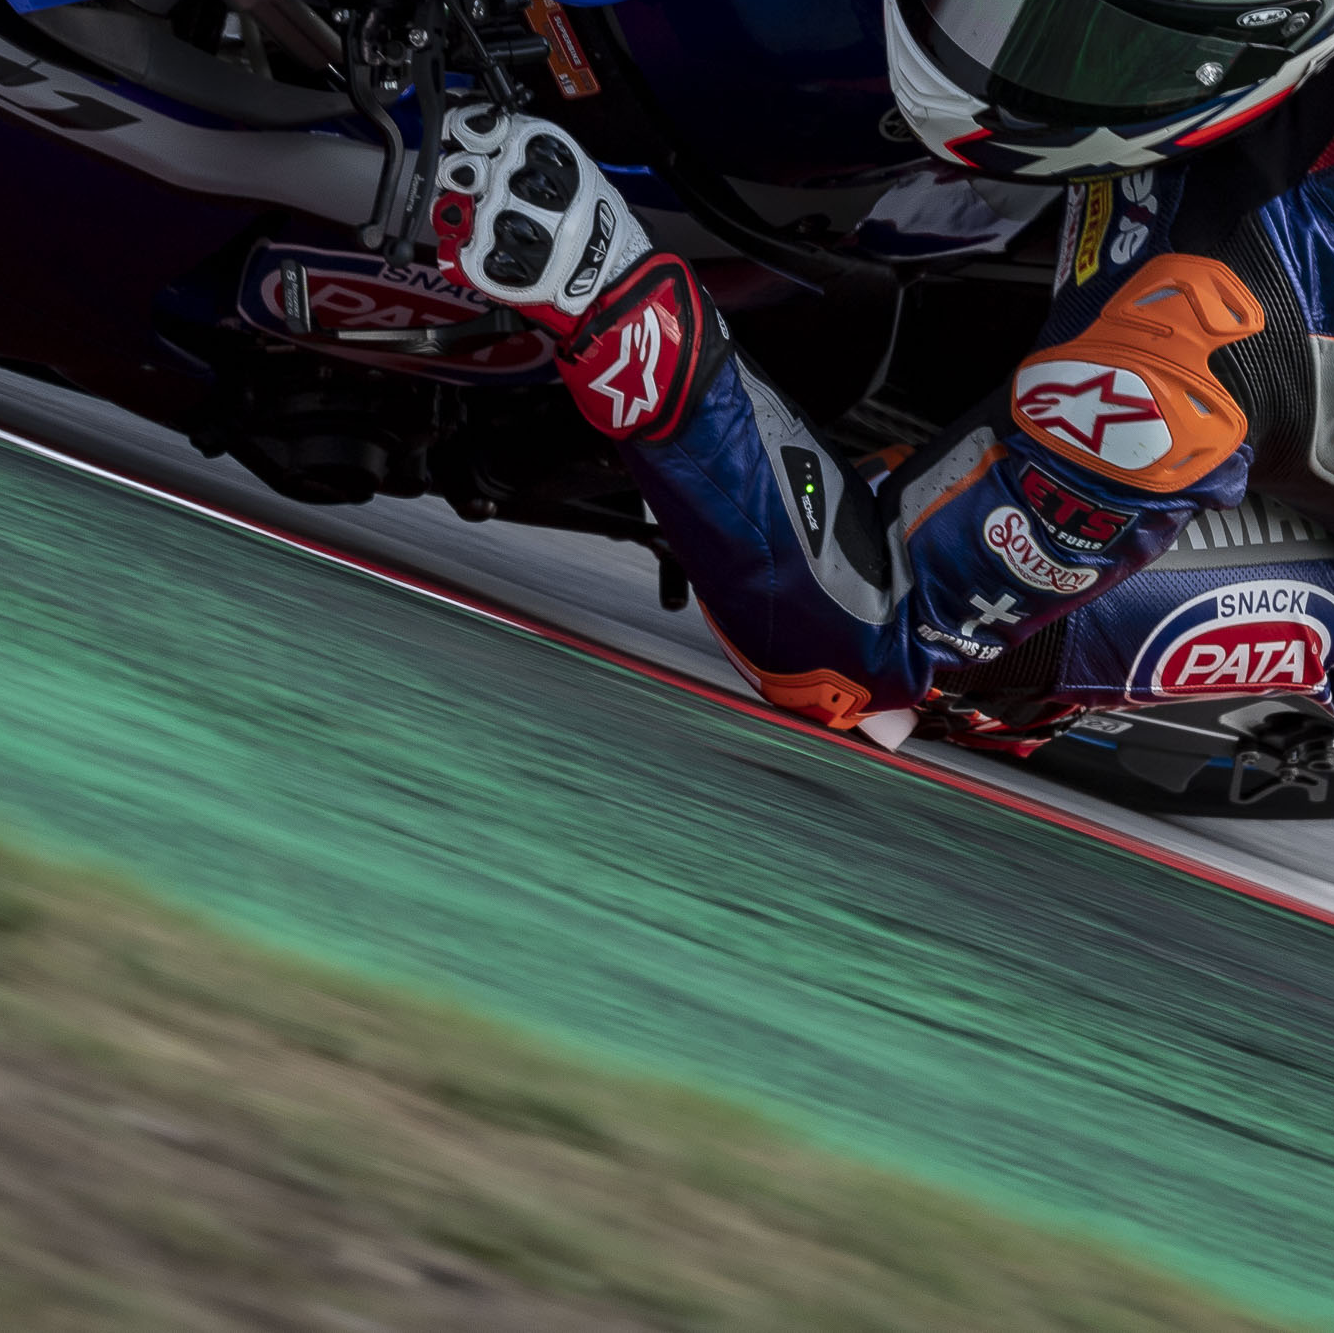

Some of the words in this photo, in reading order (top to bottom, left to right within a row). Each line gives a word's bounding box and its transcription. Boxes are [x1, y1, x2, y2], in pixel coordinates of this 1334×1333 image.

[381, 265, 486, 306] SNAC
[1020, 467, 1129, 540] ETS
[988, 511, 1088, 593] SOVERINI
[1056, 527, 1104, 552] FUELS
[1219, 590, 1305, 618] SNACK
[1174, 639, 1307, 685] PATA
